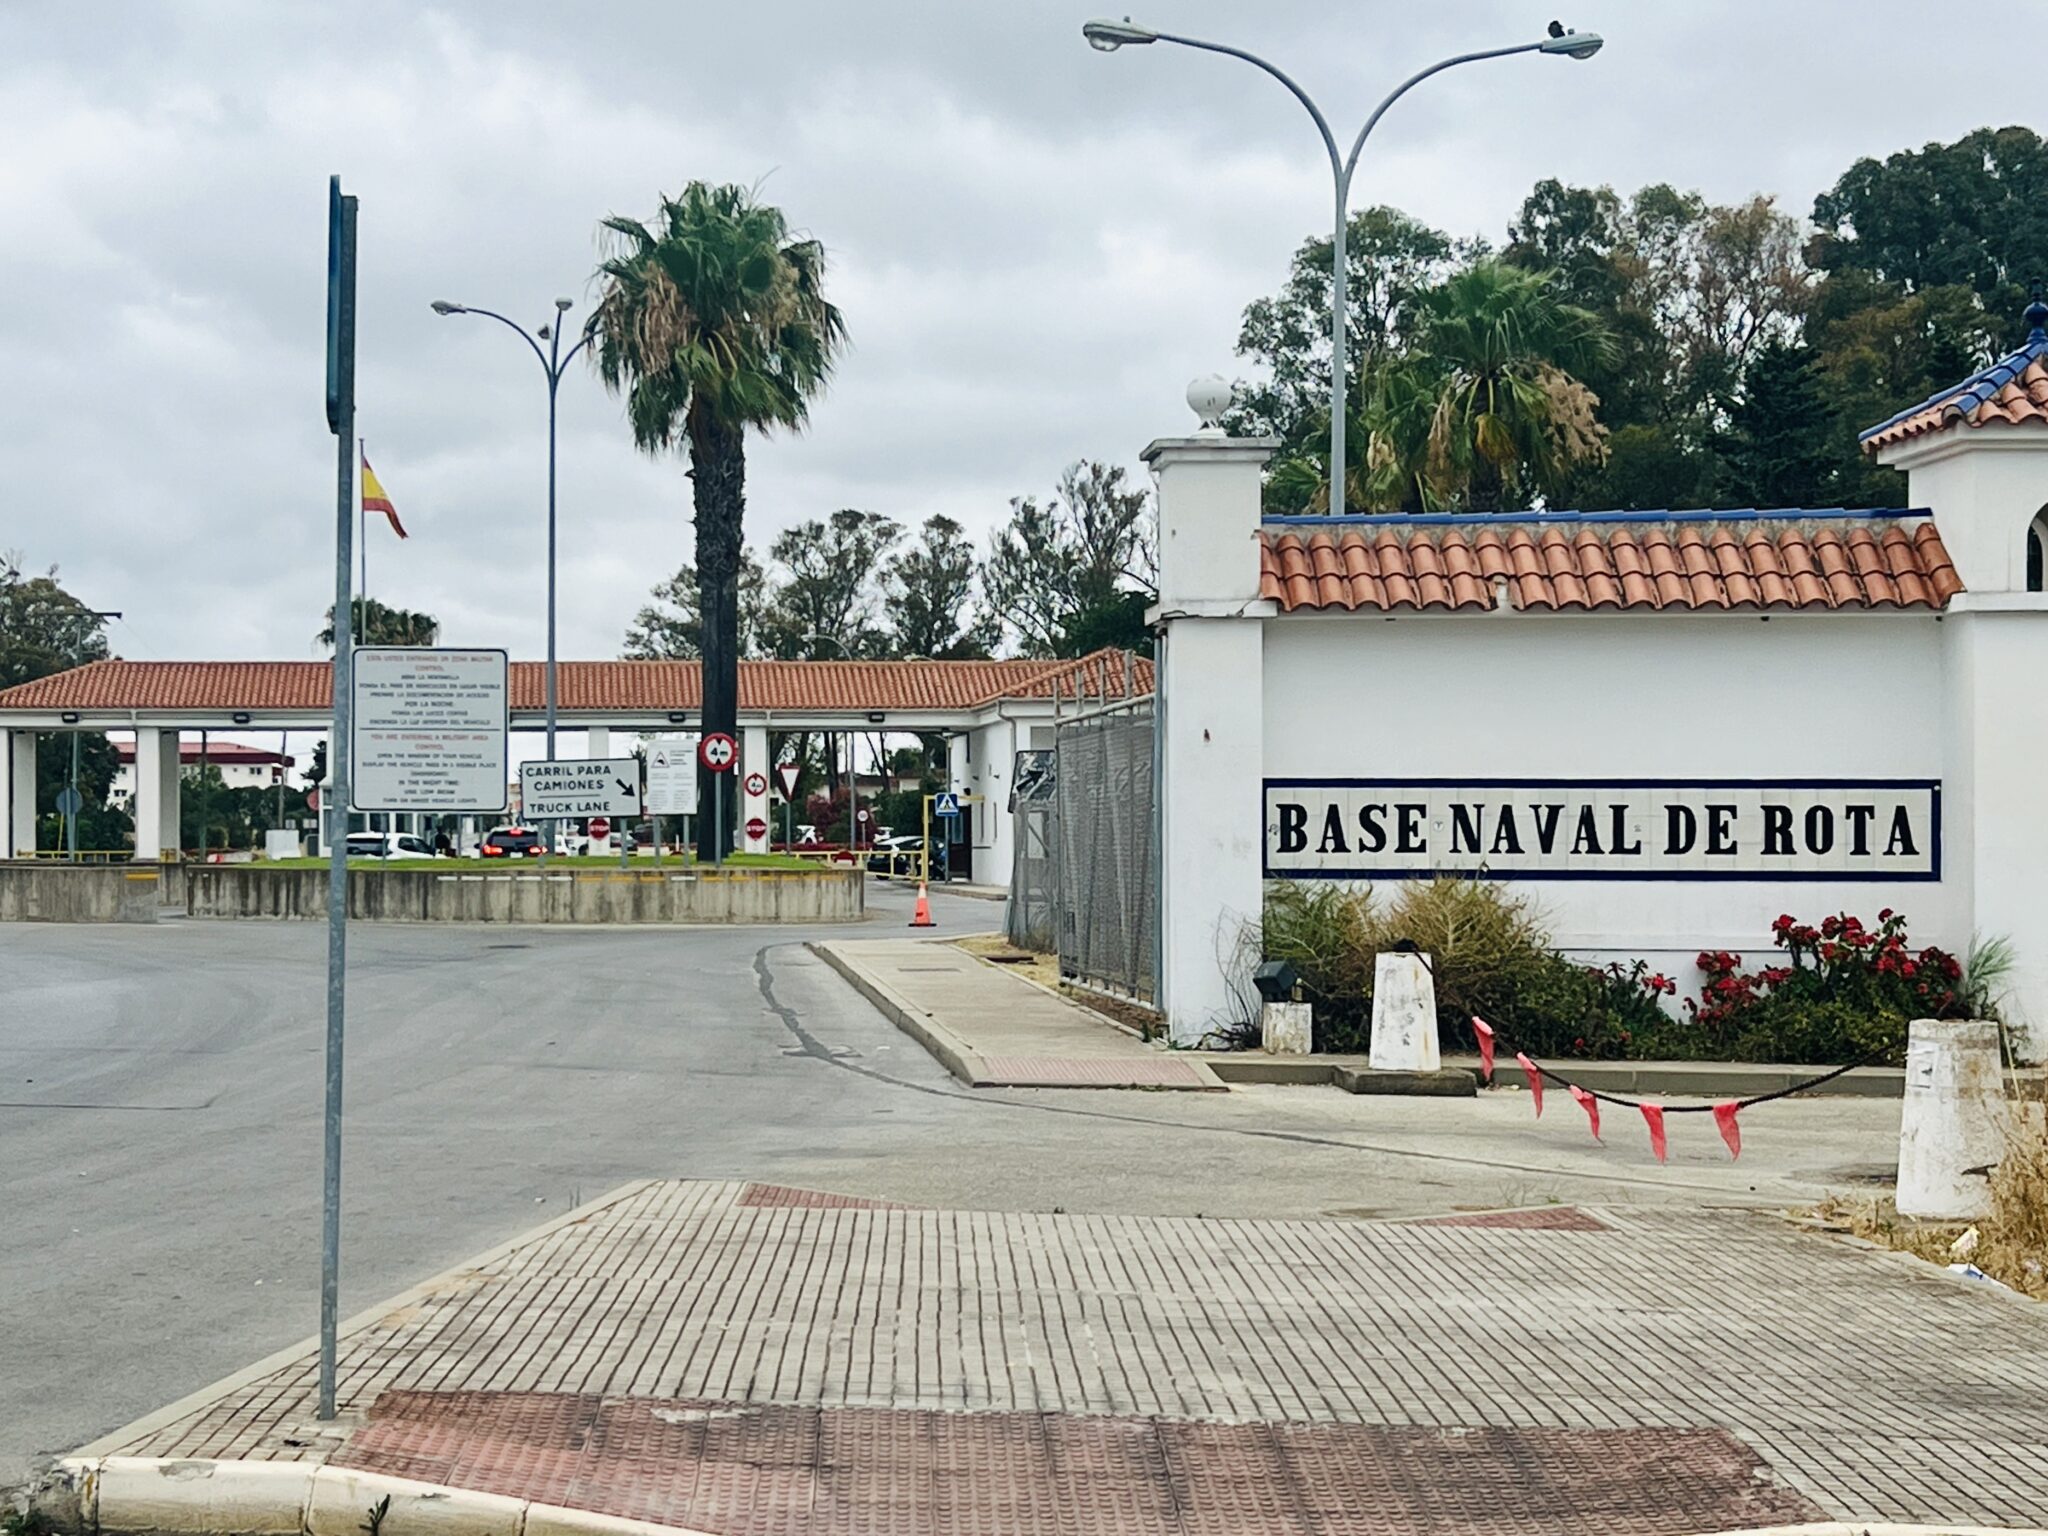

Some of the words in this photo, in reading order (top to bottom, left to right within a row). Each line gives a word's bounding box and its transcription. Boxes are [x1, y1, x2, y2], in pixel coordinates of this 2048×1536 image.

[710, 747, 719, 756] 4
[526, 766, 573, 777] CARRIL
[577, 764, 611, 775] PARA
[534, 780, 605, 791] CAMIONES
[529, 802, 573, 814] TRUCK
[577, 801, 611, 812] LANE
[589, 824, 609, 833] STOP
[1275, 803, 1428, 854] BASE
[1448, 803, 1642, 855] NAVAL
[1663, 804, 1739, 856] DE
[1760, 804, 1921, 857] ROTA
